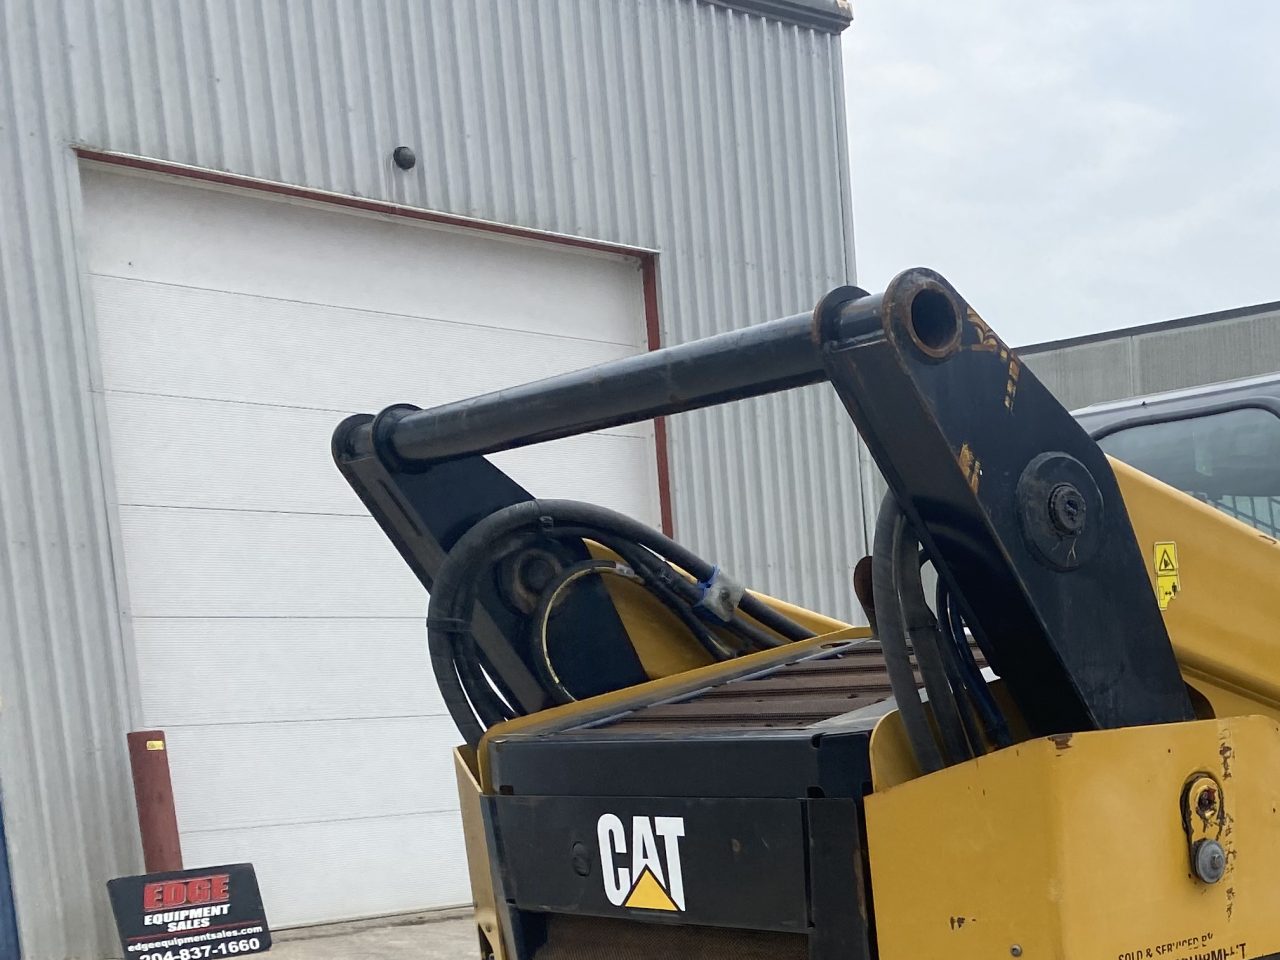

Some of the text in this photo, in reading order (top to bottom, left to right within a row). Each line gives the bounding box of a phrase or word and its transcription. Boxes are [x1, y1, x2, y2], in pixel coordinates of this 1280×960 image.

[597, 813, 686, 912] CAT
[143, 874, 230, 911] EDGE
[144, 904, 230, 926] EQUIPMENT
[167, 918, 210, 933] SALES
[127, 925, 263, 952] edgeequipmentsales.com
